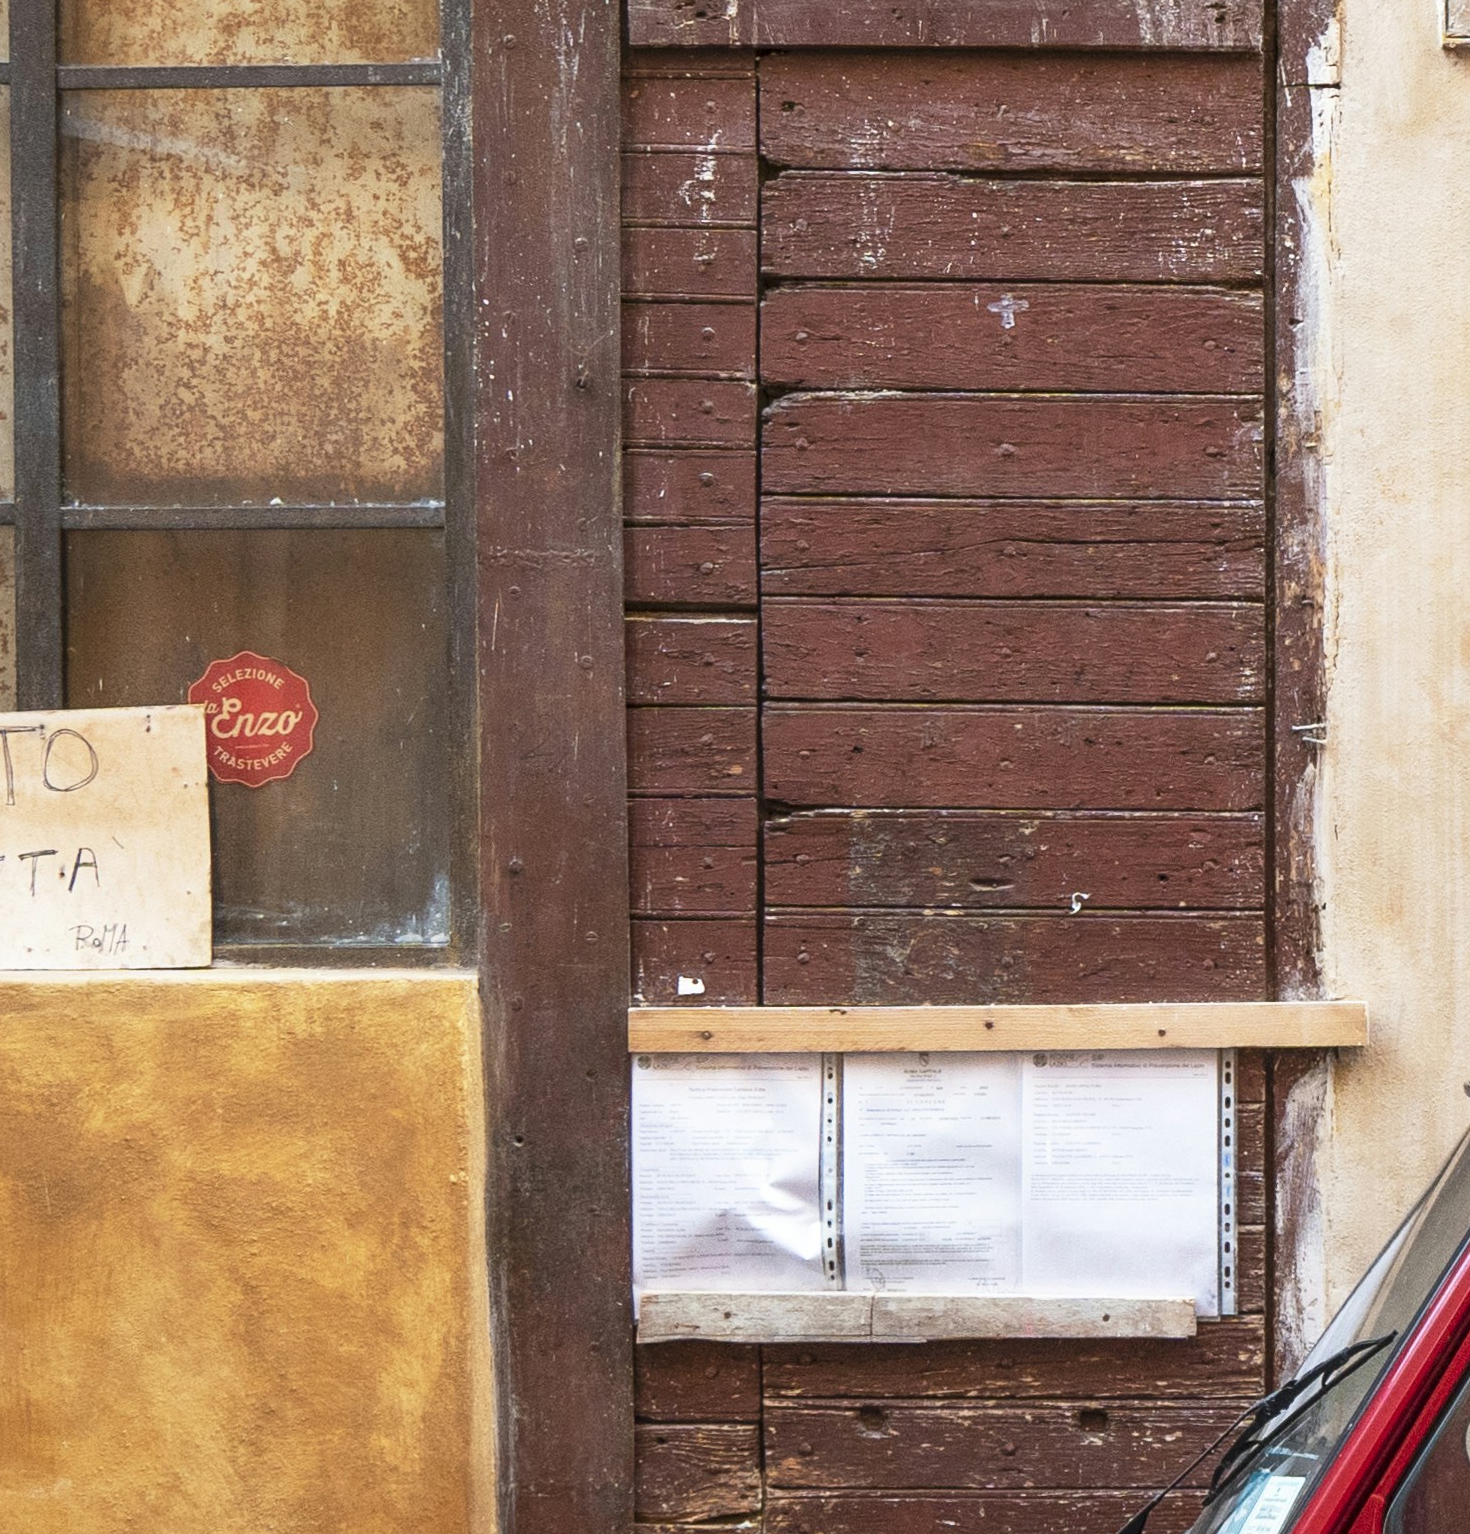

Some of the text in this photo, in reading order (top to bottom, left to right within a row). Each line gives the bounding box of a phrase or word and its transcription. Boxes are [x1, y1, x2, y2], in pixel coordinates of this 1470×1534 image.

[212, 668, 285, 693] SELEZIONE
[204, 700, 219, 714] a
[211, 697, 303, 739] Enzo
[213, 741, 293, 771] TRASTEVERE
